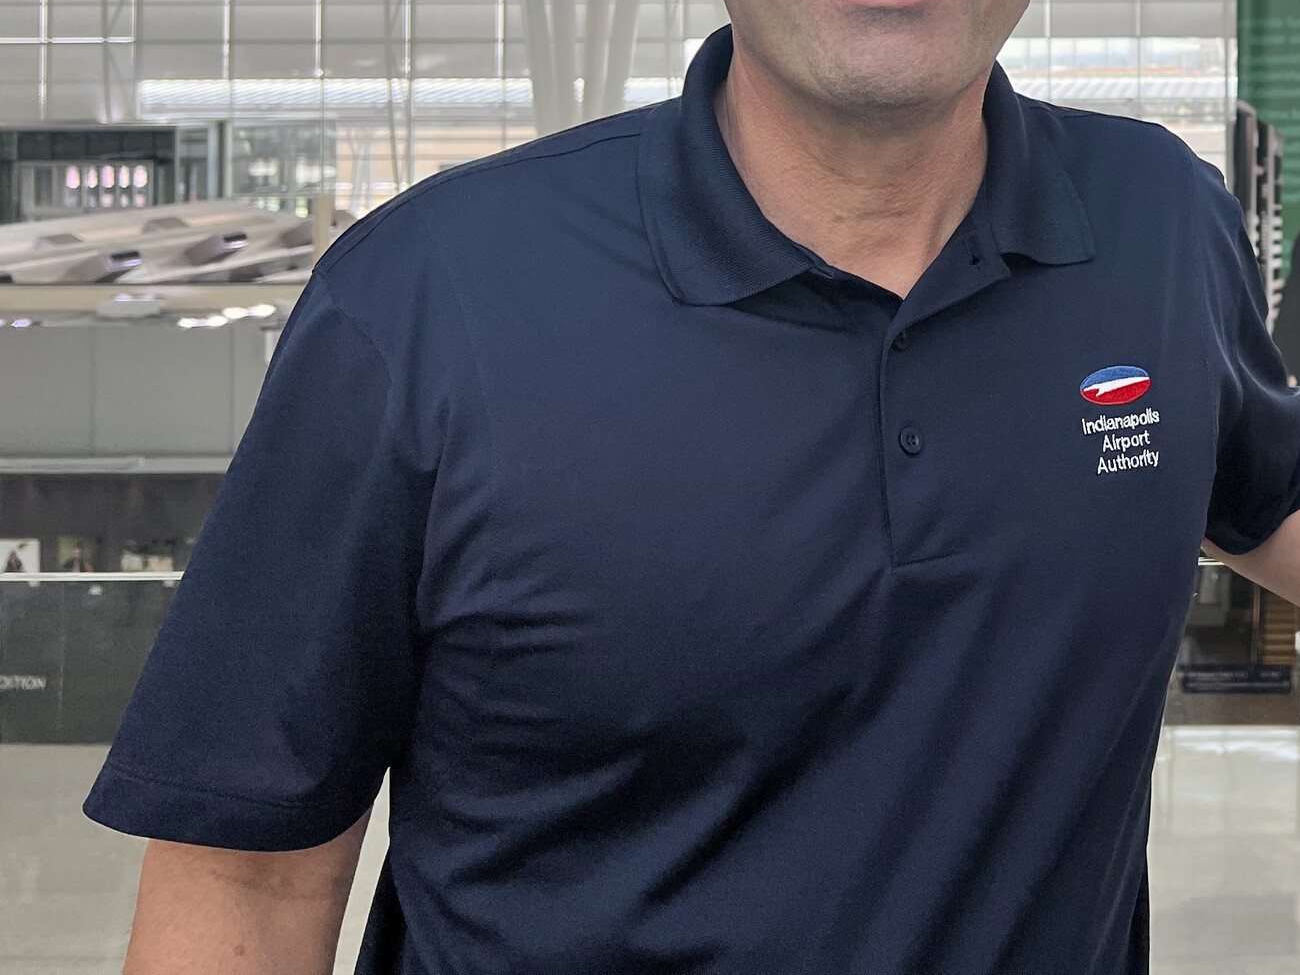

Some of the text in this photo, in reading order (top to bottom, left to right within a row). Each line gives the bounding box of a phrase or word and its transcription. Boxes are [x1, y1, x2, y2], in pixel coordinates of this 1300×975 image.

[1081, 408, 1160, 434] Indianapolis
[1102, 430, 1151, 452] Airport
[1097, 449, 1160, 474] Authority
